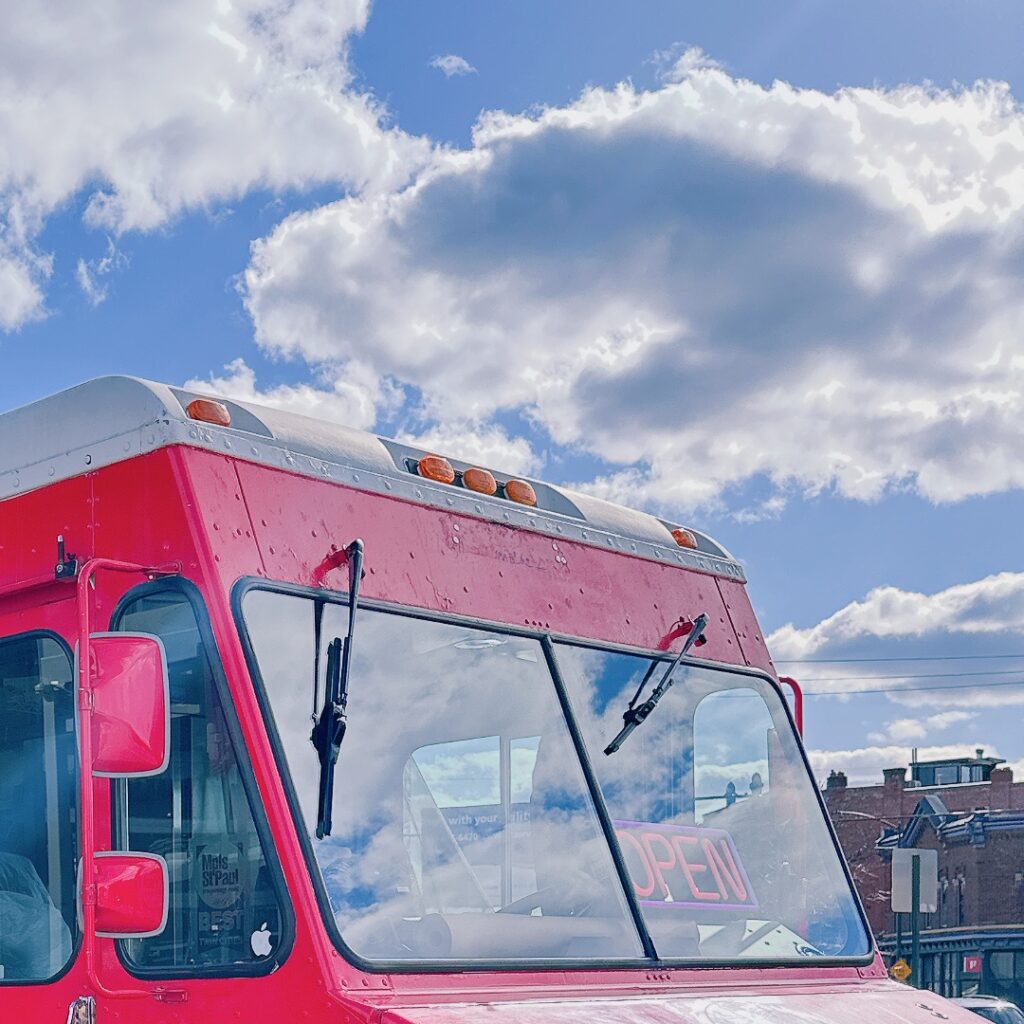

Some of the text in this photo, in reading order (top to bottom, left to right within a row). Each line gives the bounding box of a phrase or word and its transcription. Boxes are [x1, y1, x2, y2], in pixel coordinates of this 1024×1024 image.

[448, 814, 472, 825] with
[474, 814, 498, 826] your
[201, 853, 229, 871] Mpls
[616, 830, 749, 901] OPEN
[198, 910, 244, 932] BEST
